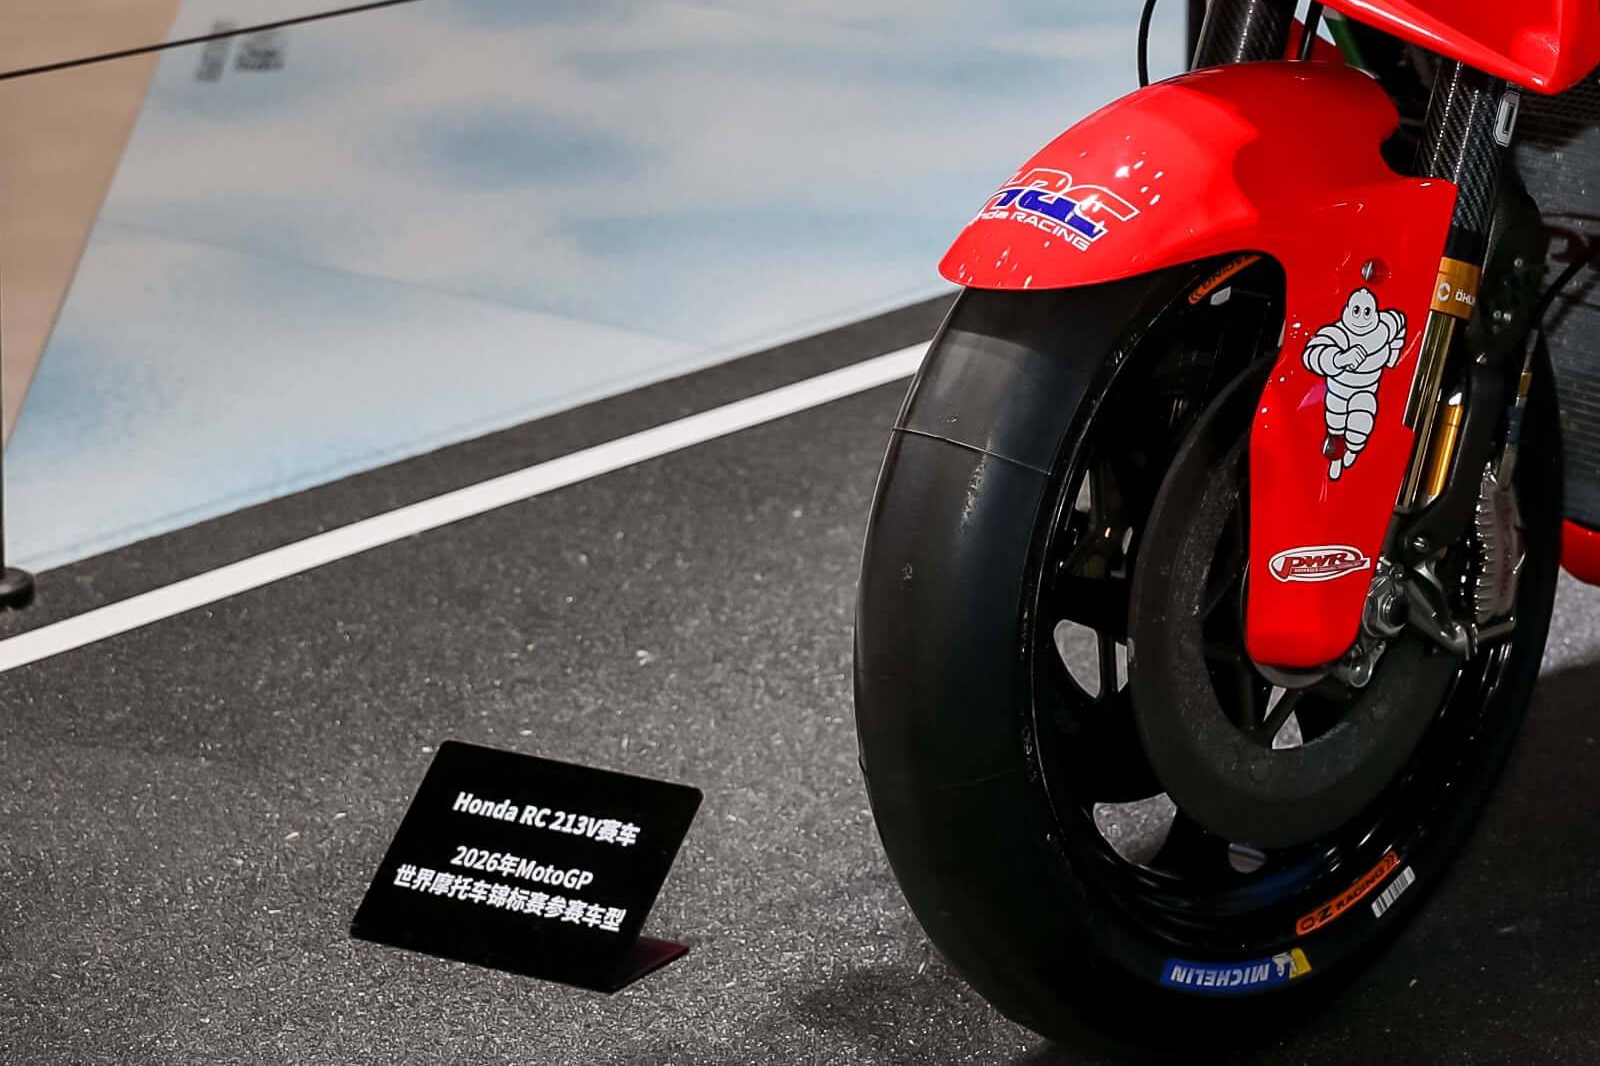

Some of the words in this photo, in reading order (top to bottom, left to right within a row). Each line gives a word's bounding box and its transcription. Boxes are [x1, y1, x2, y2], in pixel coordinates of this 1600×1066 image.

[1010, 211, 1091, 252] RACING
[1280, 552, 1358, 578] PWR
[452, 792, 518, 822] Honda
[519, 804, 548, 829] RC
[450, 845, 594, 890] 2026年MotoGP
[393, 864, 627, 932] 世界摩托车锦标赛参赛车型
[1170, 962, 1270, 987] MICHELIN
